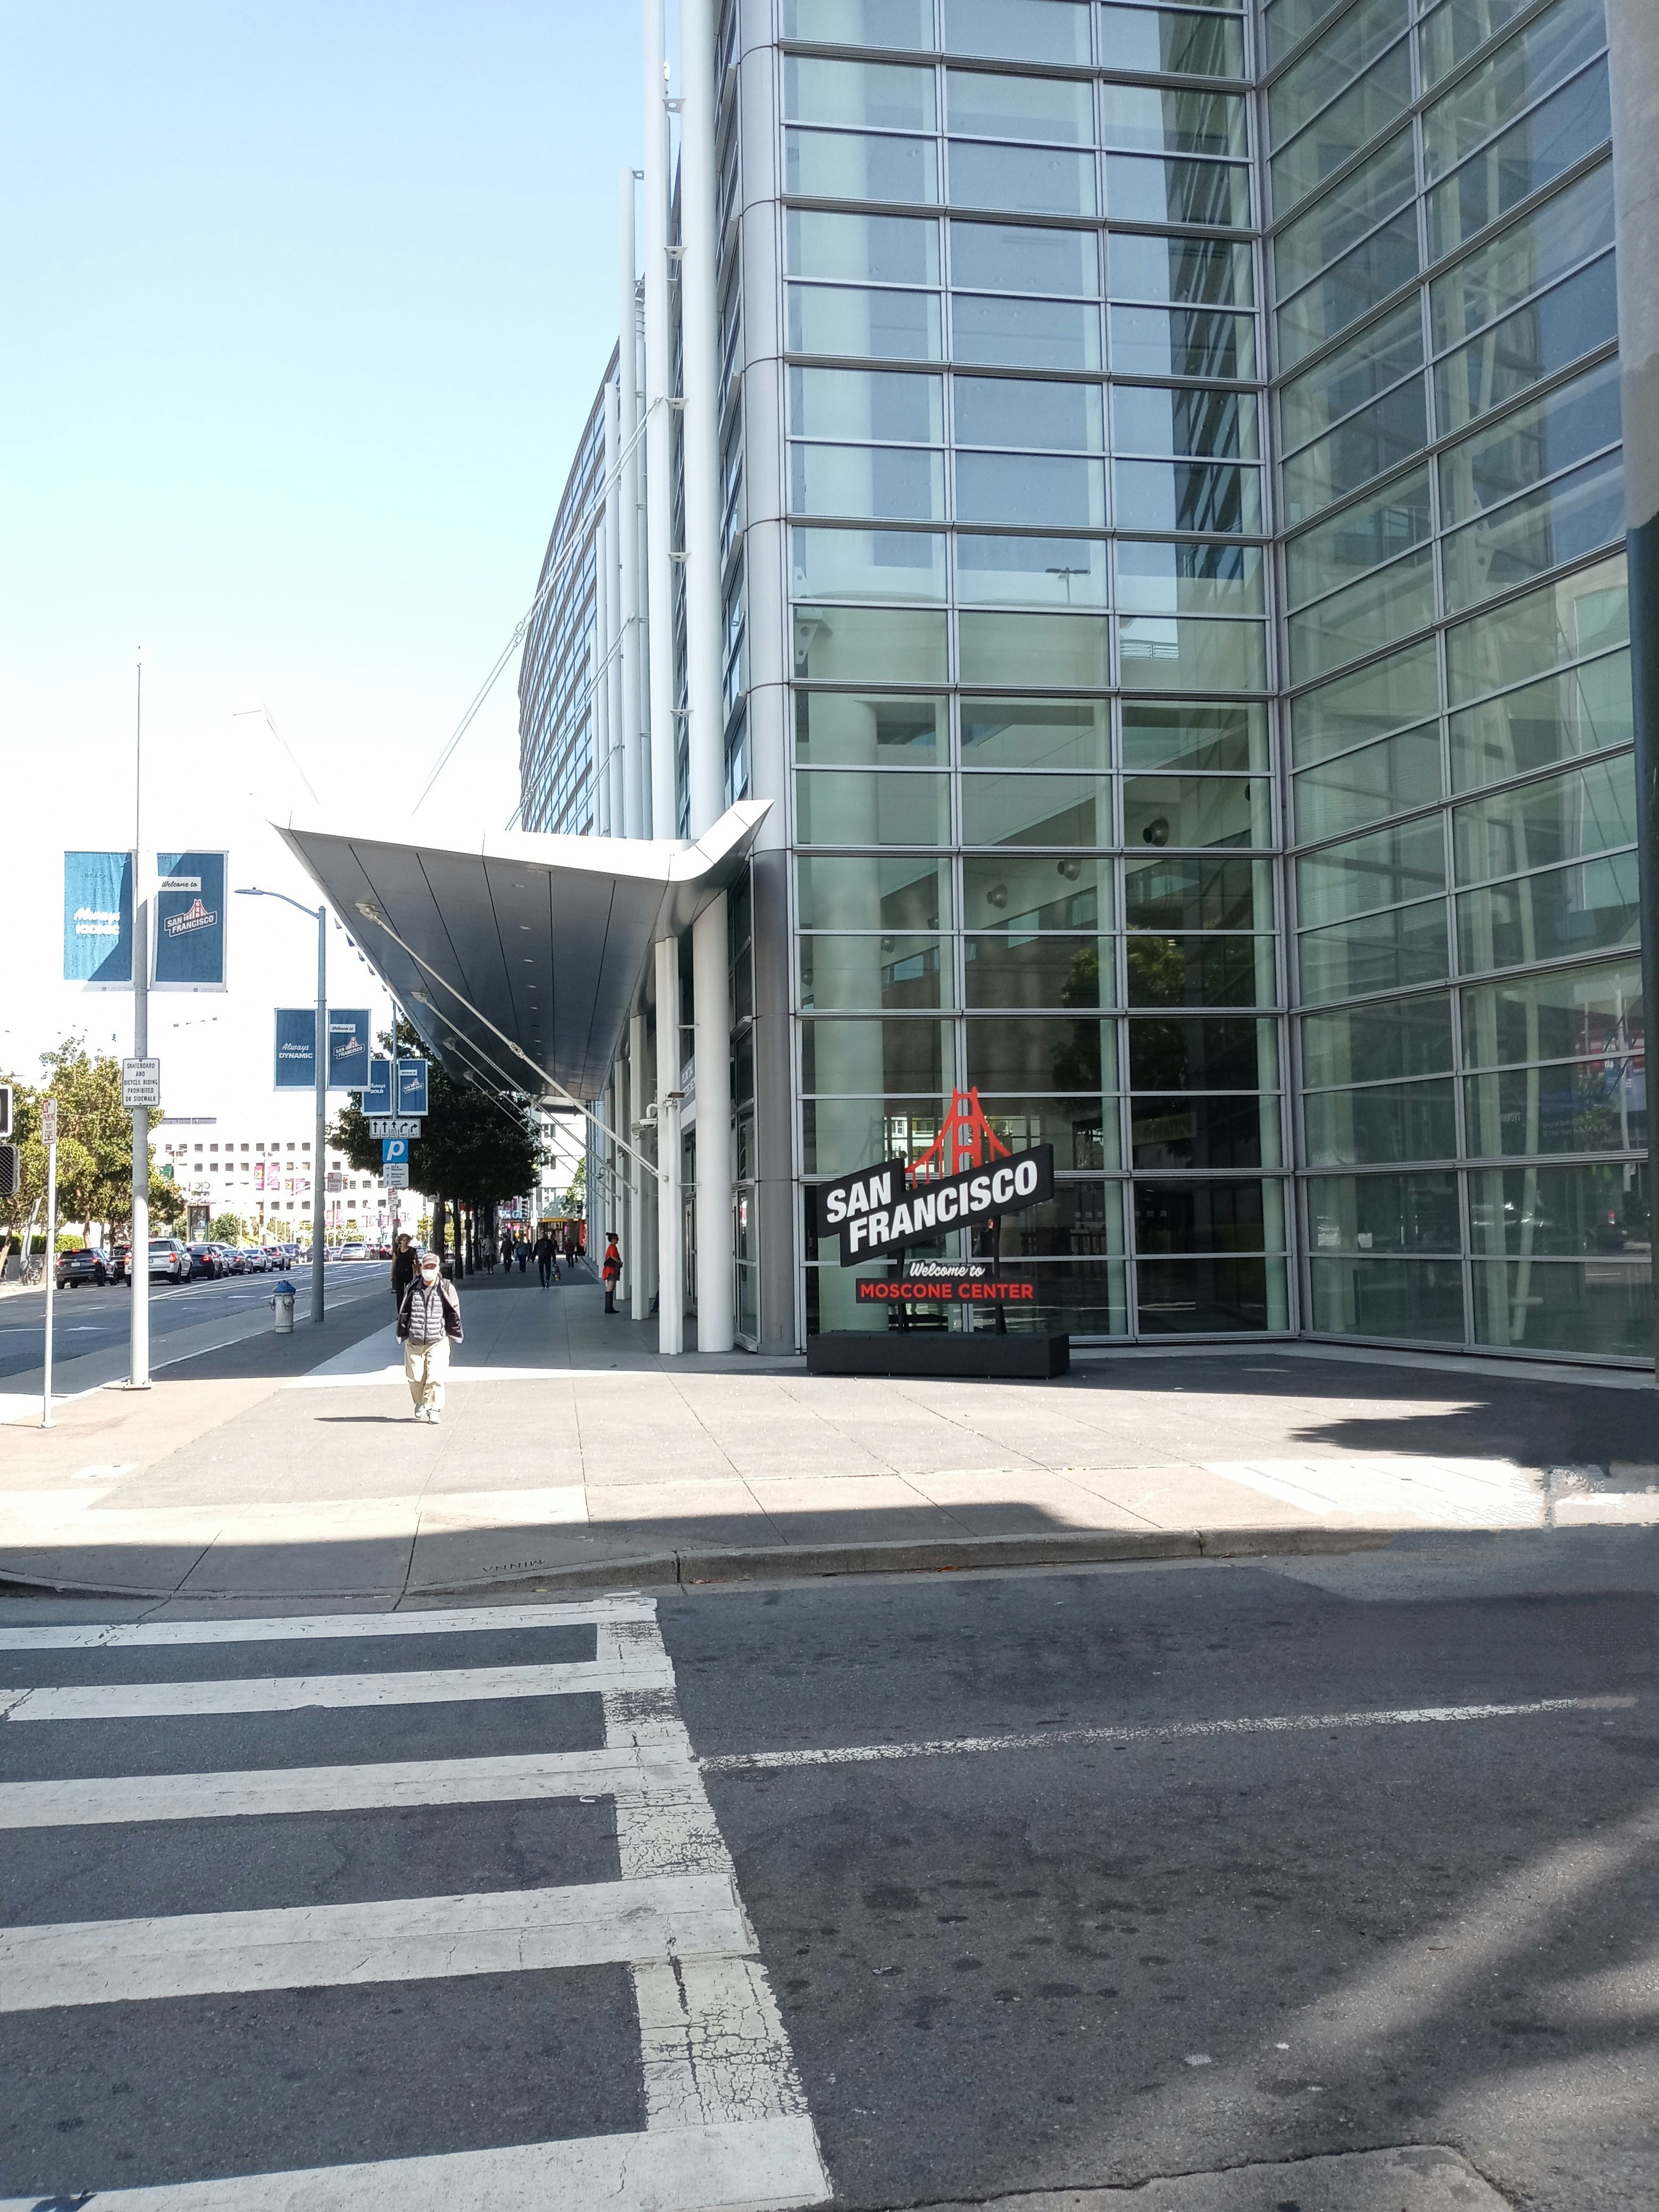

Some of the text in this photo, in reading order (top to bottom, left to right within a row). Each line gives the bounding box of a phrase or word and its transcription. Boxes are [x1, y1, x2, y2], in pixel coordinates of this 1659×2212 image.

[167, 916, 183, 927] SAN
[172, 915, 214, 934] FRANCISCO
[282, 1043, 309, 1053] Always
[337, 1046, 364, 1058] FRANCISCO
[406, 1084, 423, 1093] FRANCISCO
[826, 1171, 892, 1224] SAN
[849, 1160, 1038, 1254] FRANCISCO
[909, 1262, 986, 1277] Welcome to
[860, 1283, 1034, 1299] MOSCONE CENTER
